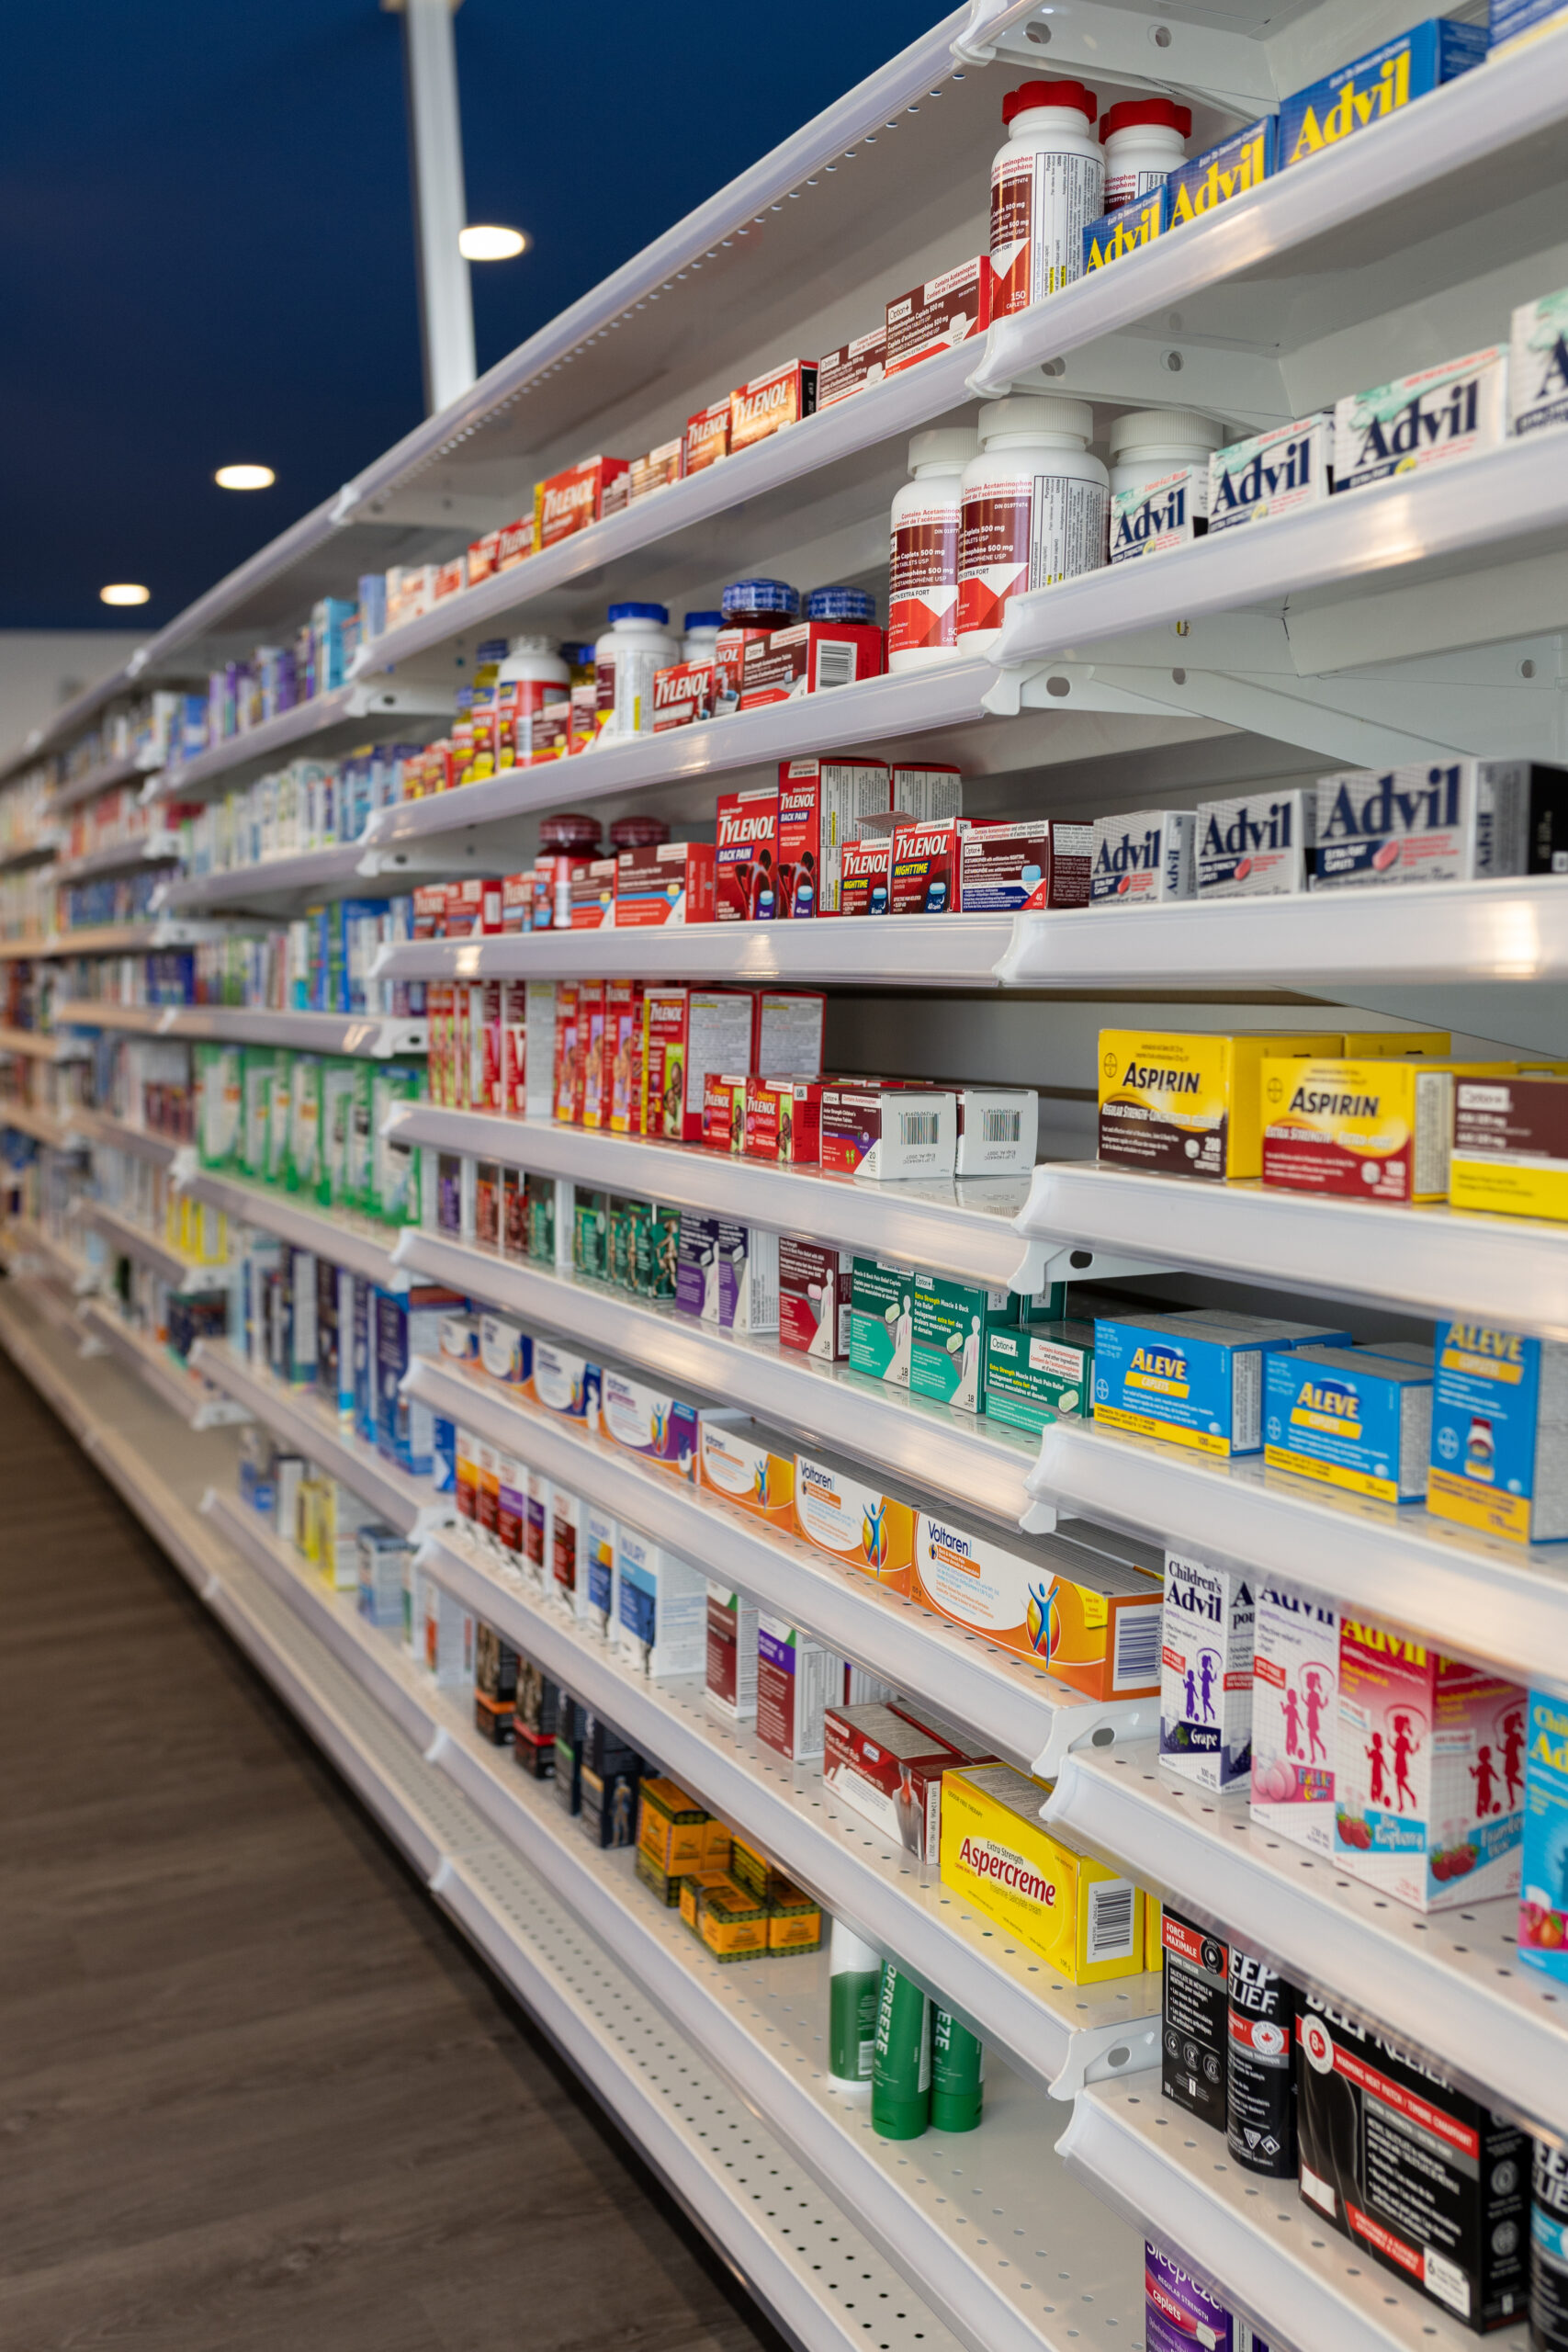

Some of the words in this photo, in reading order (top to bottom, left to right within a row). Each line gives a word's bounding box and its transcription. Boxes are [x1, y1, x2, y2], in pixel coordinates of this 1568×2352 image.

[1289, 49, 1410, 164] Advil
[1169, 135, 1266, 230] Advil
[1086, 201, 1160, 275] Advil
[1010, 289, 1026, 301] 150
[730, 379, 789, 431] TYLENOL
[688, 412, 729, 450] TYLENOL
[1355, 379, 1479, 467] Advil
[983, 481, 1032, 491] Acetaminophen
[1211, 437, 1311, 516] Advil
[1113, 487, 1185, 548] Advil
[934, 548, 945, 557] mg
[654, 671, 710, 710] TYLENOL
[780, 792, 815, 810] TYLENOL
[781, 812, 795, 822] BACK
[795, 811, 808, 821] PAIN
[1321, 764, 1461, 840] Advil
[719, 815, 775, 847] TYLENOL
[1200, 802, 1292, 856] Advil
[718, 849, 735, 862] BACK
[736, 847, 752, 860] PAIN
[895, 834, 948, 862] TYLENOL
[1094, 830, 1161, 874] Advil
[843, 852, 888, 877] TYLENOL
[894, 863, 929, 876] NIGHTTIME
[843, 878, 869, 889] NIGHTTIME
[649, 1002, 682, 1023] TYLENOL
[1122, 1062, 1200, 1094] ASPIRIN
[705, 1091, 729, 1108] TYLENOL
[748, 1096, 775, 1114] TYLENOL
[1289, 1086, 1380, 1117] ASPIRIN
[869, 1150, 876, 1159] 20
[992, 1338, 1013, 1351] Option+
[1446, 1322, 1524, 1363] ALEVE
[901, 1366, 908, 1377] 18
[1130, 1348, 1187, 1381] ALEVE
[967, 1394, 975, 1404] 18
[1297, 1382, 1359, 1419] ALEVE
[800, 1460, 832, 1490] Voltaren
[928, 1521, 969, 1556] Voltaren
[1168, 1559, 1223, 1595] Children's
[1166, 1580, 1222, 1623] Advil
[1233, 1611, 1255, 1630] pou
[1190, 1727, 1218, 1752] Grape
[1298, 1767, 1331, 1788] Bubble
[987, 1840, 1001, 1854] Extra
[1001, 1847, 1024, 1866] Strength
[960, 1838, 1056, 1906] Aspercreme
[1166, 1922, 1185, 1940] FORCE
[1166, 1934, 1198, 1959] MAXIMALE
[1230, 1947, 1280, 1989] EEP
[876, 1963, 897, 2056] OFREEZE
[1229, 1976, 1279, 2014] ELIEF
[1311, 2032, 1319, 2052] 8
[1153, 2290, 1181, 2322] caplets
[1157, 2274, 1181, 2299] REGULAR
[1180, 2295, 1209, 2322] STRENGTH
